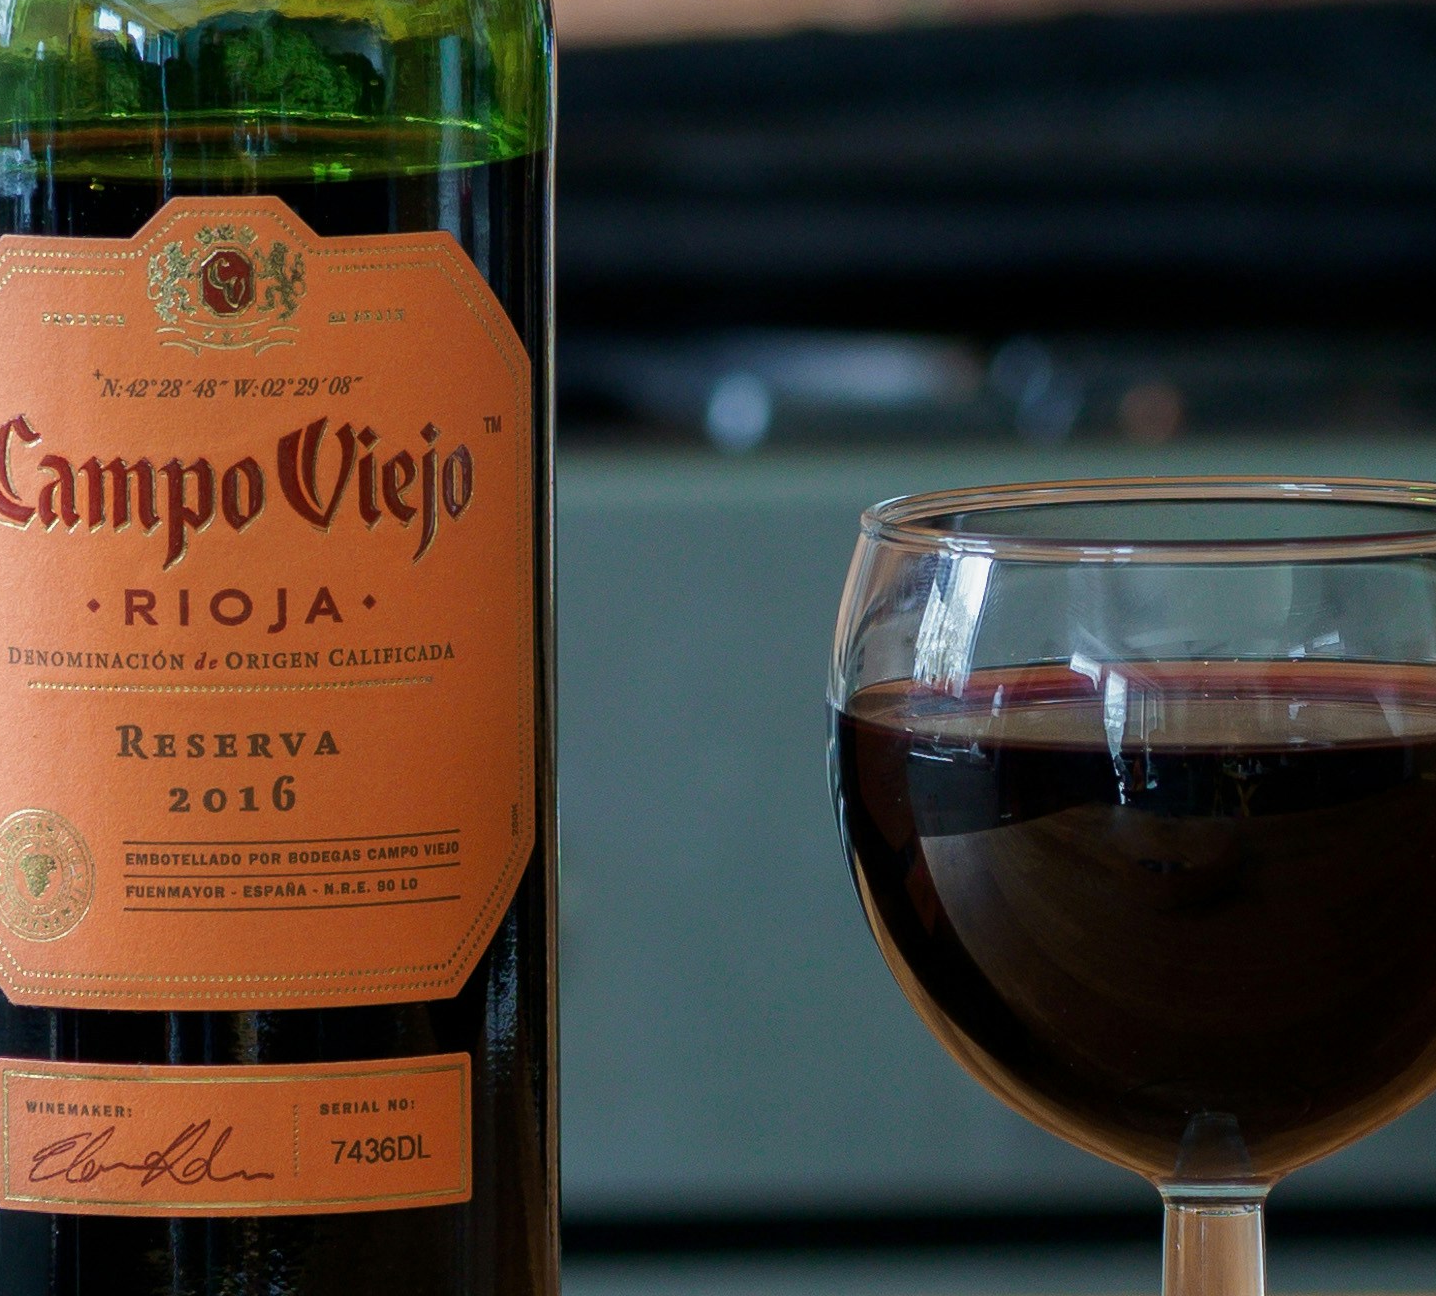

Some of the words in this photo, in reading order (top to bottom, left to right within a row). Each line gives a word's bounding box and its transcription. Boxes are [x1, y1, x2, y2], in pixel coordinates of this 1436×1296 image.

[275, 415, 475, 565] Viejo
[124, 586, 344, 634] RIOJA
[7, 645, 186, 671] DENOMINACIÓN
[193, 651, 219, 671] de
[225, 650, 321, 671] ORIGEN
[328, 641, 456, 669] CALIFICADA
[115, 723, 341, 761] RESERVA
[168, 774, 298, 814] 2016
[125, 851, 242, 866] EMBOTELLADO
[248, 851, 282, 866] POR
[288, 848, 362, 865] BODEGAS
[366, 844, 419, 862] CAMPO
[423, 840, 460, 857] VIEJO
[125, 884, 226, 899] FUENMAYOR
[242, 881, 307, 899] ESPAÑA
[25, 1100, 133, 1119] WINEMAKER:
[319, 1100, 381, 1116] SERIAL
[387, 1097, 417, 1113] NO:
[330, 1134, 432, 1166] 7436DL
